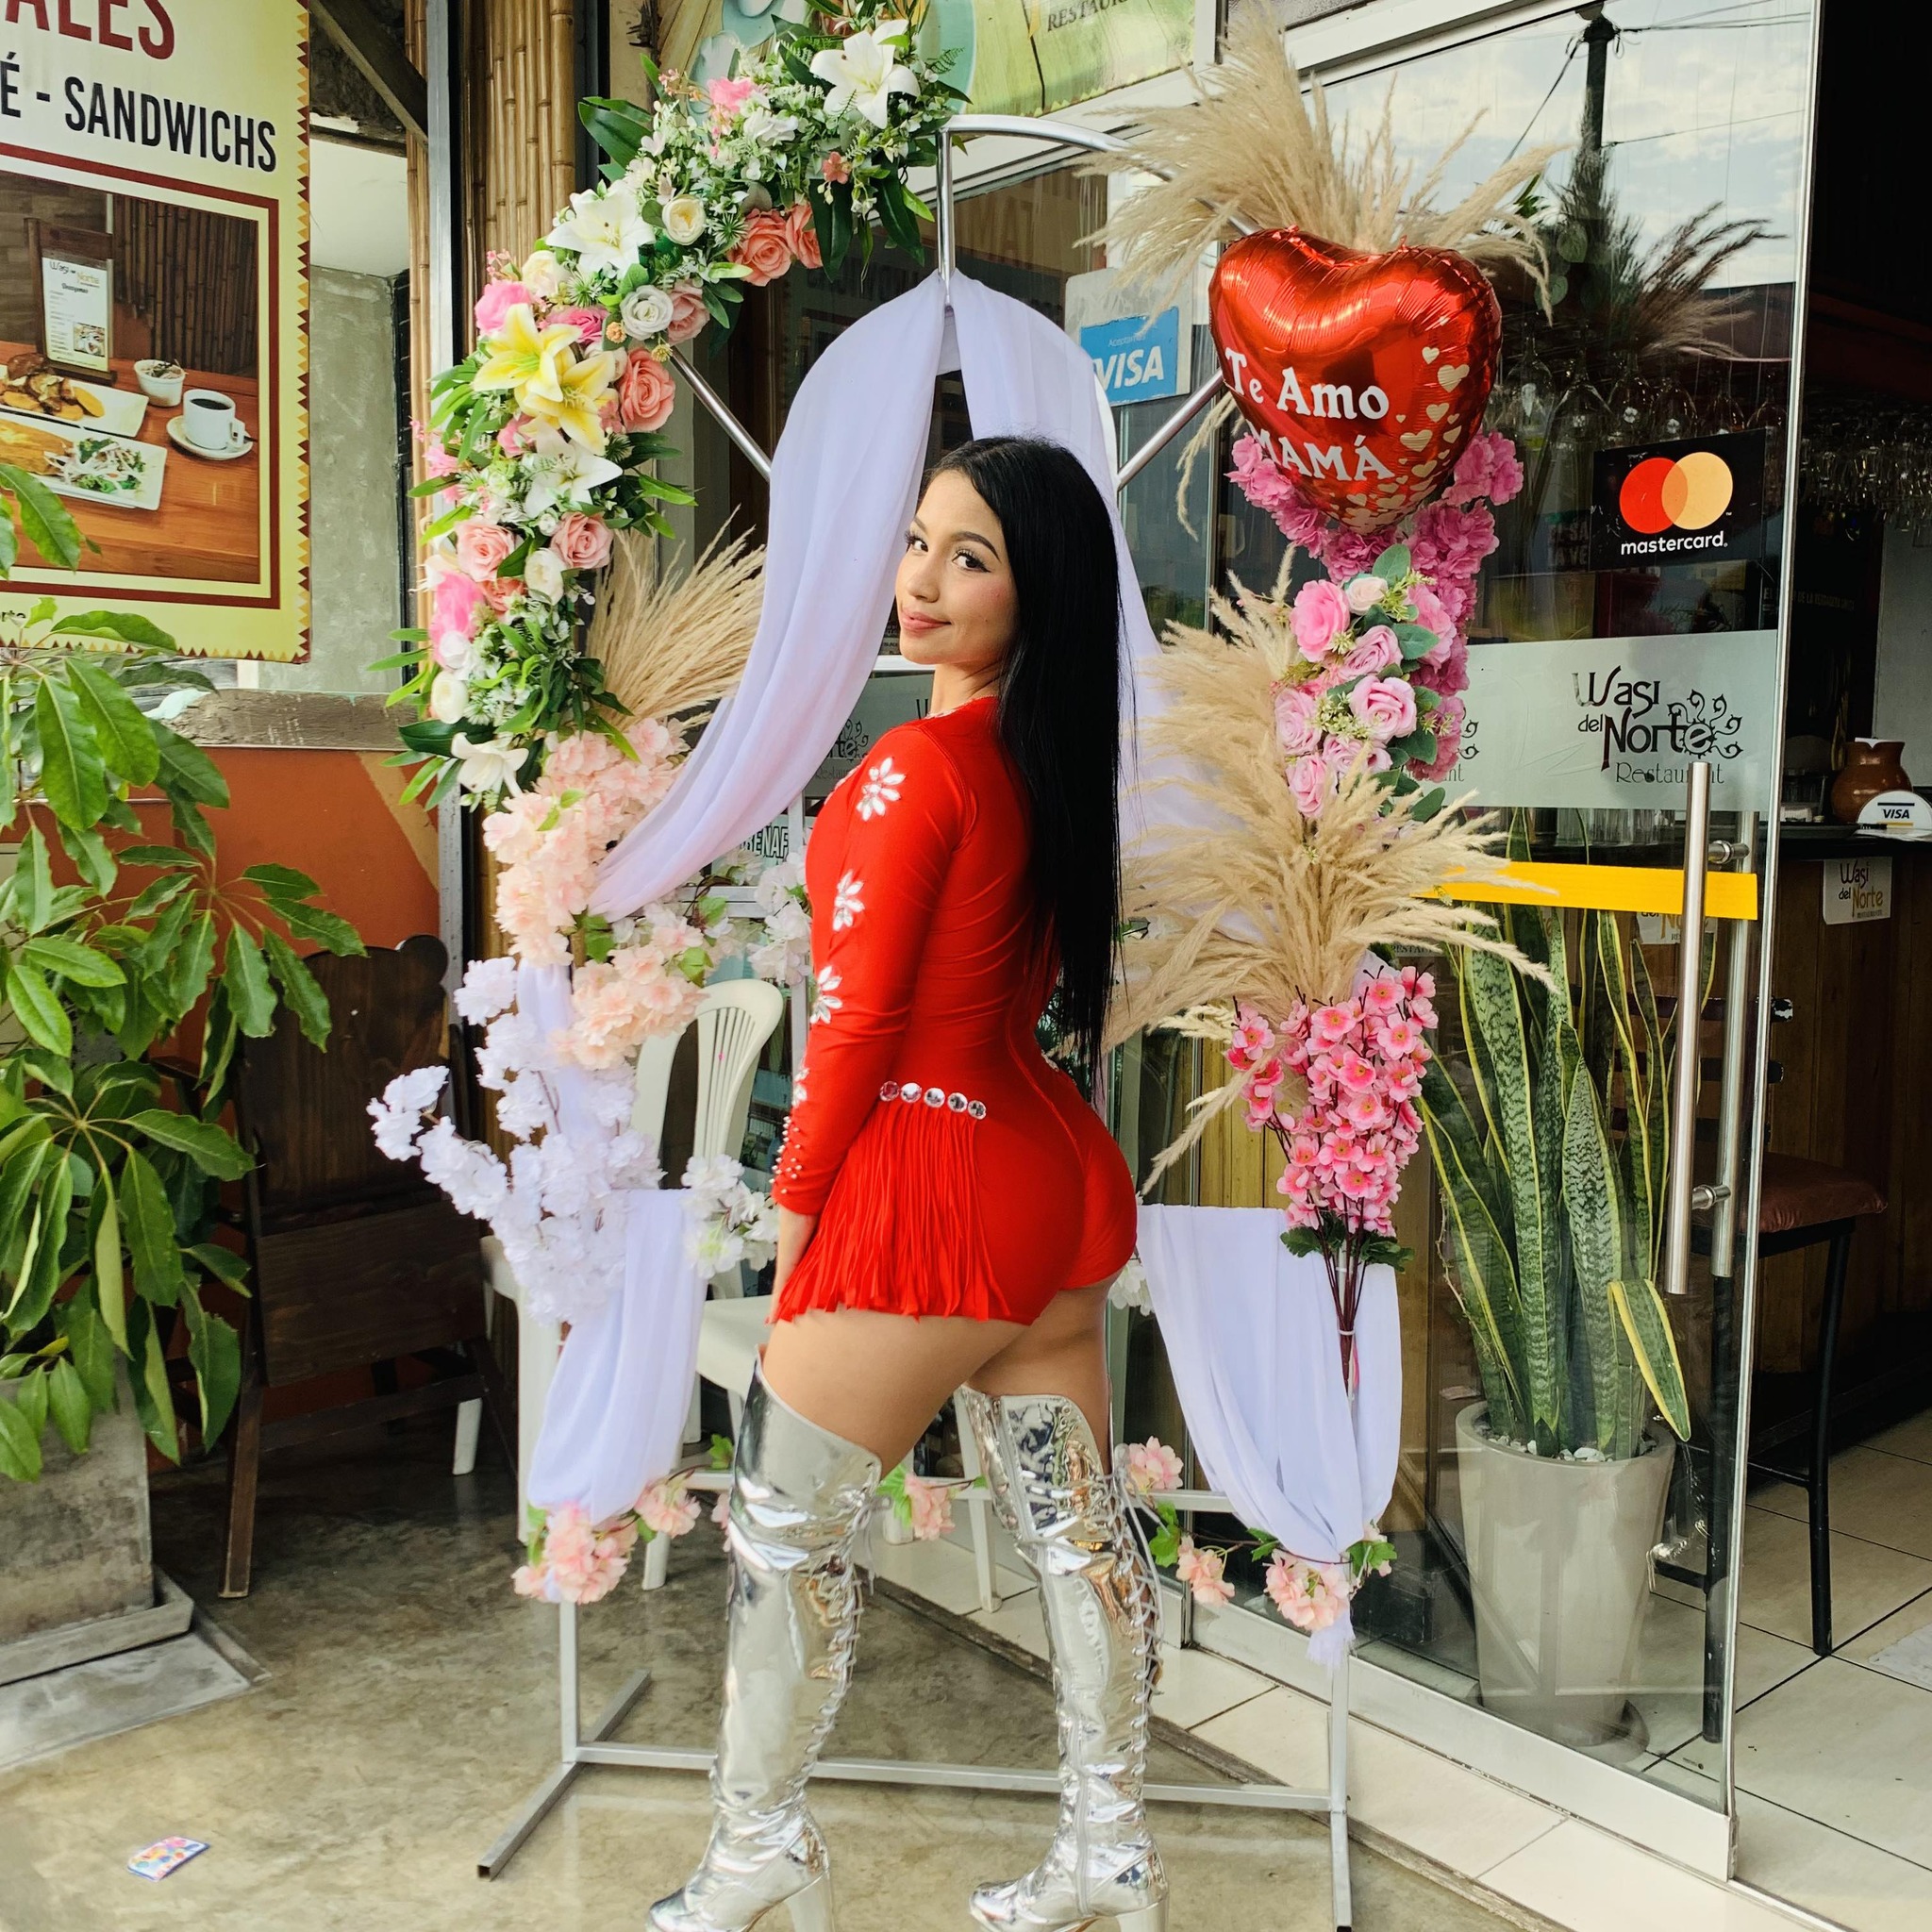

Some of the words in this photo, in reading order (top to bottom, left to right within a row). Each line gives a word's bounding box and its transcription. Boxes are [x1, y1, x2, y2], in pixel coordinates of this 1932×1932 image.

[5, 0, 175, 60] ES
[64, 75, 277, 174] SANDWICHS
[1092, 345, 1165, 392] VISA
[1224, 346, 1265, 404] Te
[1275, 366, 1390, 421] Amo
[1246, 419, 1396, 482] MAMÁ
[1620, 530, 1724, 556] mastercard
[1572, 665, 1661, 720] Wasi
[1577, 713, 1604, 733] del
[1601, 706, 1718, 773] Norte
[1616, 761, 1724, 785] Restaut
[1882, 808, 1910, 820] VISA
[1840, 859, 1870, 889] Wasi
[1838, 887, 1852, 900] del
[1852, 884, 1884, 919] Norte
